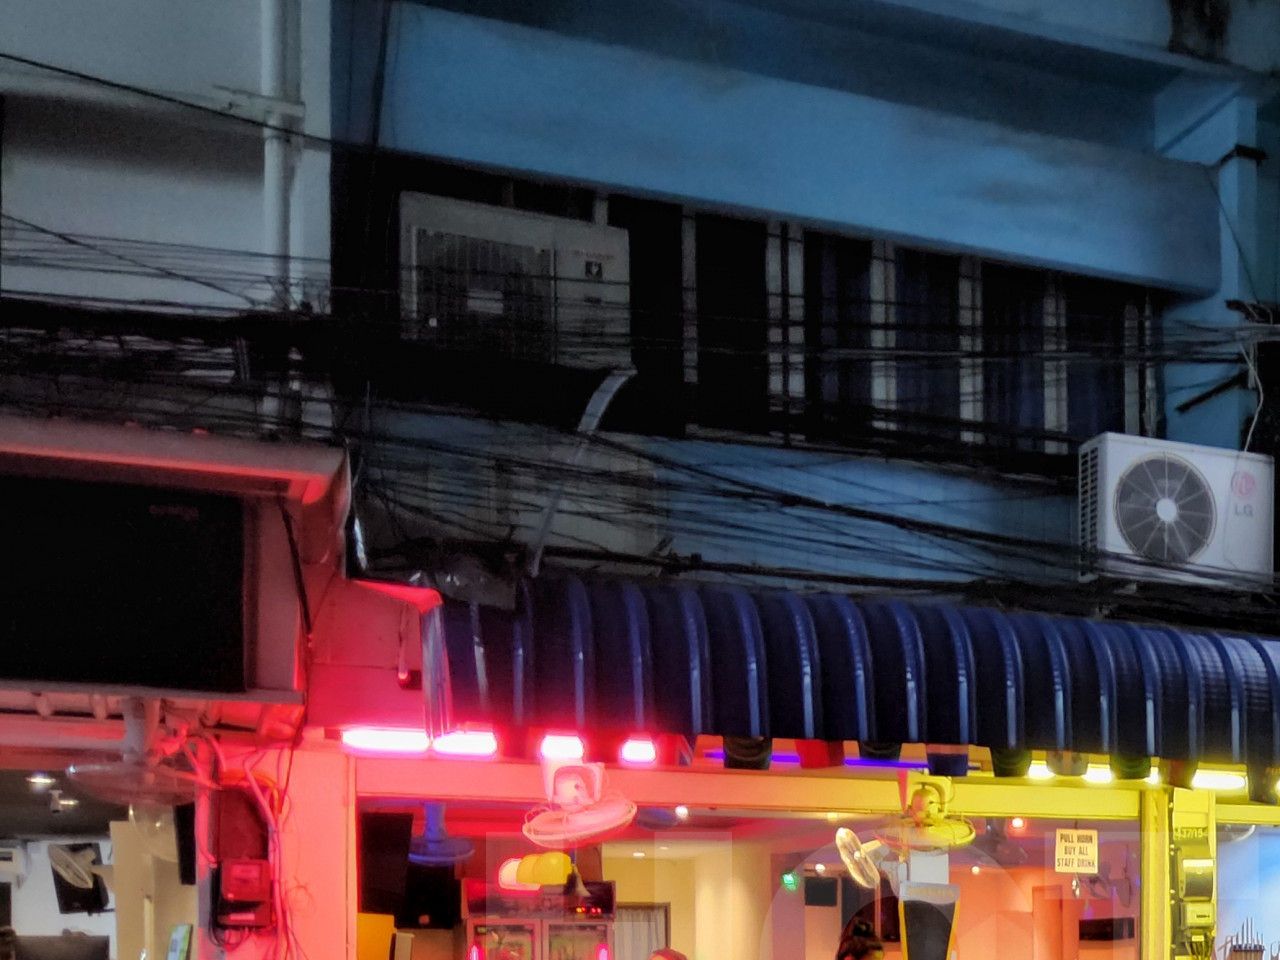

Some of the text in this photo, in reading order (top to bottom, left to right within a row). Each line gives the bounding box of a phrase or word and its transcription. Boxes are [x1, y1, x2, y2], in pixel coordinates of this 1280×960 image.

[1234, 503, 1254, 518] LG
[1060, 833, 1074, 844] PULL
[1078, 845, 1089, 857] ALL
[1056, 858, 1075, 868] STAFF
